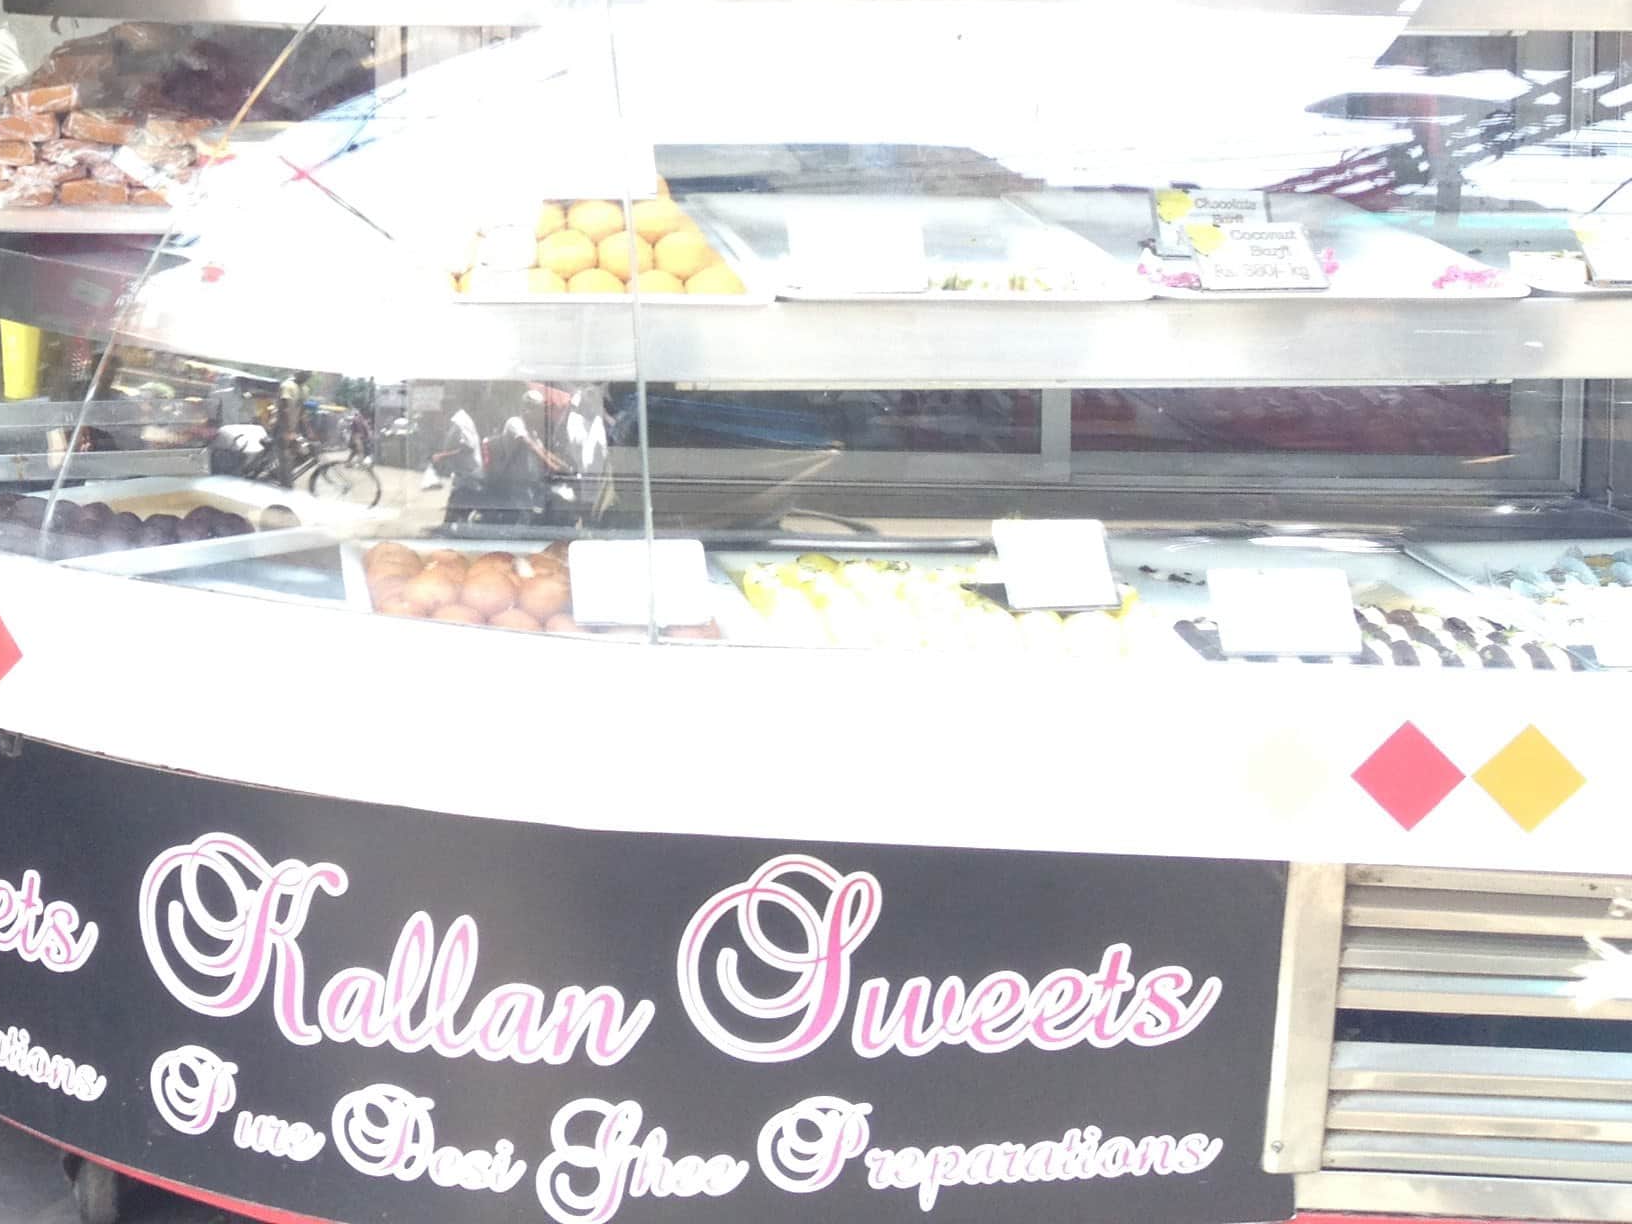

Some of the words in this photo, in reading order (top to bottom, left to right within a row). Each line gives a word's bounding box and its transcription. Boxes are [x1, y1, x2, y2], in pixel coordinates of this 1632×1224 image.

[1229, 229, 1297, 241] Coconut
[139, 832, 656, 1067] Kallan
[676, 853, 1222, 1063] Sweets
[150, 1044, 326, 1162] Pure
[331, 1083, 527, 1193] Desi
[536, 1097, 749, 1224] Ghee
[756, 1094, 1223, 1212] Preparations
